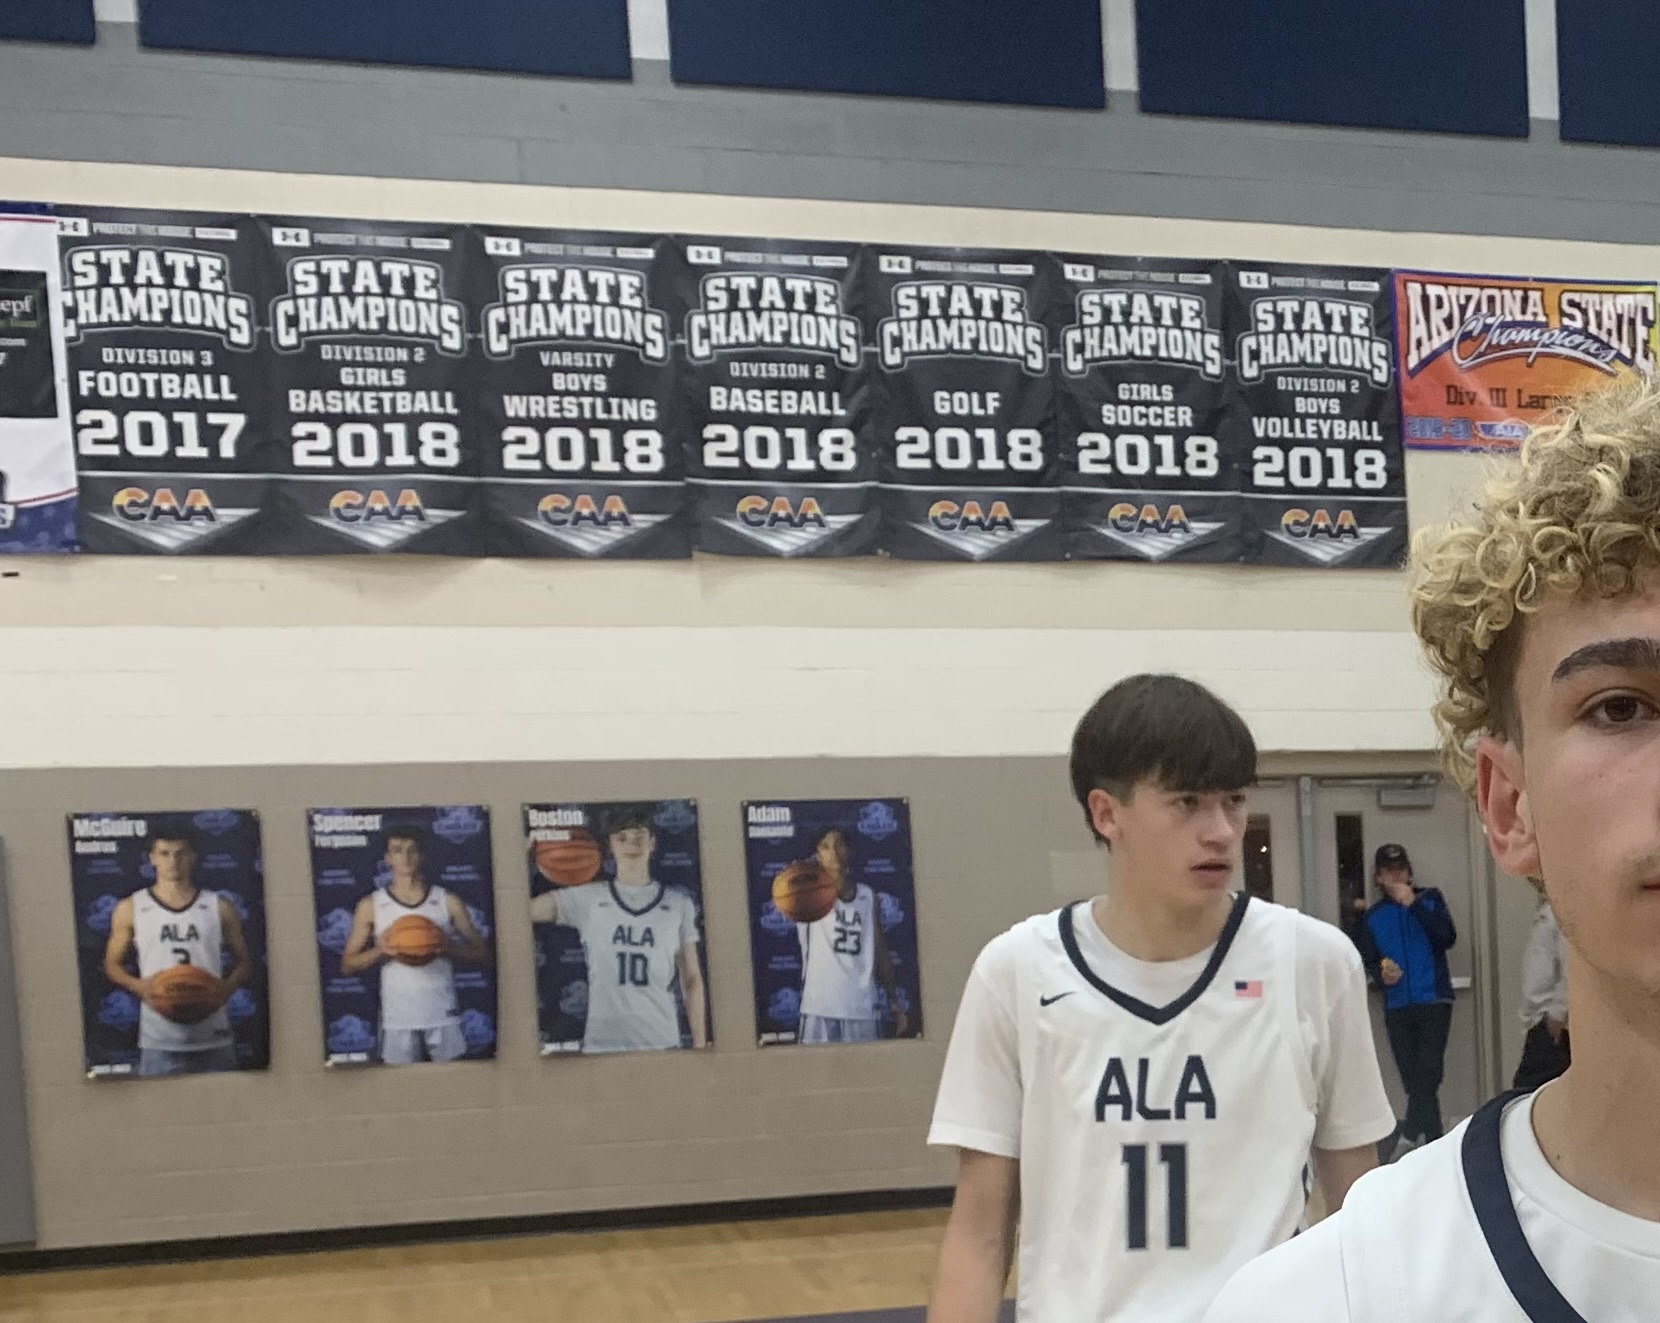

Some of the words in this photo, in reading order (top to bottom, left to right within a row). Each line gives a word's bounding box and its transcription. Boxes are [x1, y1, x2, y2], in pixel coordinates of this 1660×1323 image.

[72, 250, 225, 291] STATE
[295, 259, 438, 298] STATE
[505, 268, 642, 306] STATE
[706, 276, 837, 315] STATE
[898, 285, 1024, 322] STATE
[1082, 293, 1202, 328] STATE
[62, 287, 251, 346] CHAMPIONS
[276, 297, 461, 351] CHAMPIONS
[487, 303, 665, 358] CHAMPIONS
[1255, 301, 1371, 336] STATE
[1407, 282, 1546, 370] ARIZONA
[1561, 291, 1656, 377] STATE
[321, 344, 408, 363] DIVISION
[414, 348, 425, 363] 2
[689, 312, 857, 365] CHAMPIONS
[883, 318, 1044, 371] CHAMPIONS
[1066, 325, 1222, 376] CHAMPIONS
[1453, 313, 1619, 377] Champions
[102, 348, 195, 366] DIVISION
[201, 352, 213, 365] 3
[540, 351, 615, 368] VARSITY
[730, 362, 809, 379] DIVISION
[815, 364, 825, 379] 2
[1242, 332, 1388, 382] CHAMPIONS
[79, 370, 237, 401] FOOTBALL
[340, 368, 406, 387] GIRLS
[552, 373, 607, 391] BOYS
[1118, 383, 1173, 401] GIRLS
[1277, 376, 1346, 393] DIVISION
[1350, 378, 1360, 393] 2
[289, 390, 458, 415] BASKETBALL
[503, 395, 657, 421] WRESTLING
[710, 386, 846, 416] BASEBALL
[934, 391, 1000, 416] GOLF
[1102, 404, 1193, 427] SOCCER
[1295, 397, 1340, 414] BOYS
[76, 410, 246, 458] 2017
[291, 422, 460, 467] 2018
[1252, 417, 1382, 441] VOLLEYBALL
[502, 426, 664, 473] 2018
[703, 424, 857, 470] 2018
[895, 427, 1044, 471] 2018
[1077, 432, 1219, 477] 2018
[1252, 446, 1387, 490] 2018
[112, 487, 216, 522] CAA
[330, 490, 426, 523] CAA
[538, 494, 632, 527] CAA
[736, 495, 827, 528] CAA
[929, 500, 1016, 532] CAA
[1109, 503, 1193, 534] CAA
[1281, 509, 1361, 540] CAA
[528, 809, 584, 827] Boston
[748, 805, 791, 823] Adam
[160, 924, 199, 943] ALA
[612, 924, 654, 947] ALA
[834, 927, 861, 956] 23
[616, 951, 648, 987] 10
[1094, 1055, 1216, 1122] ALA
[1121, 1142, 1189, 1251] 11
